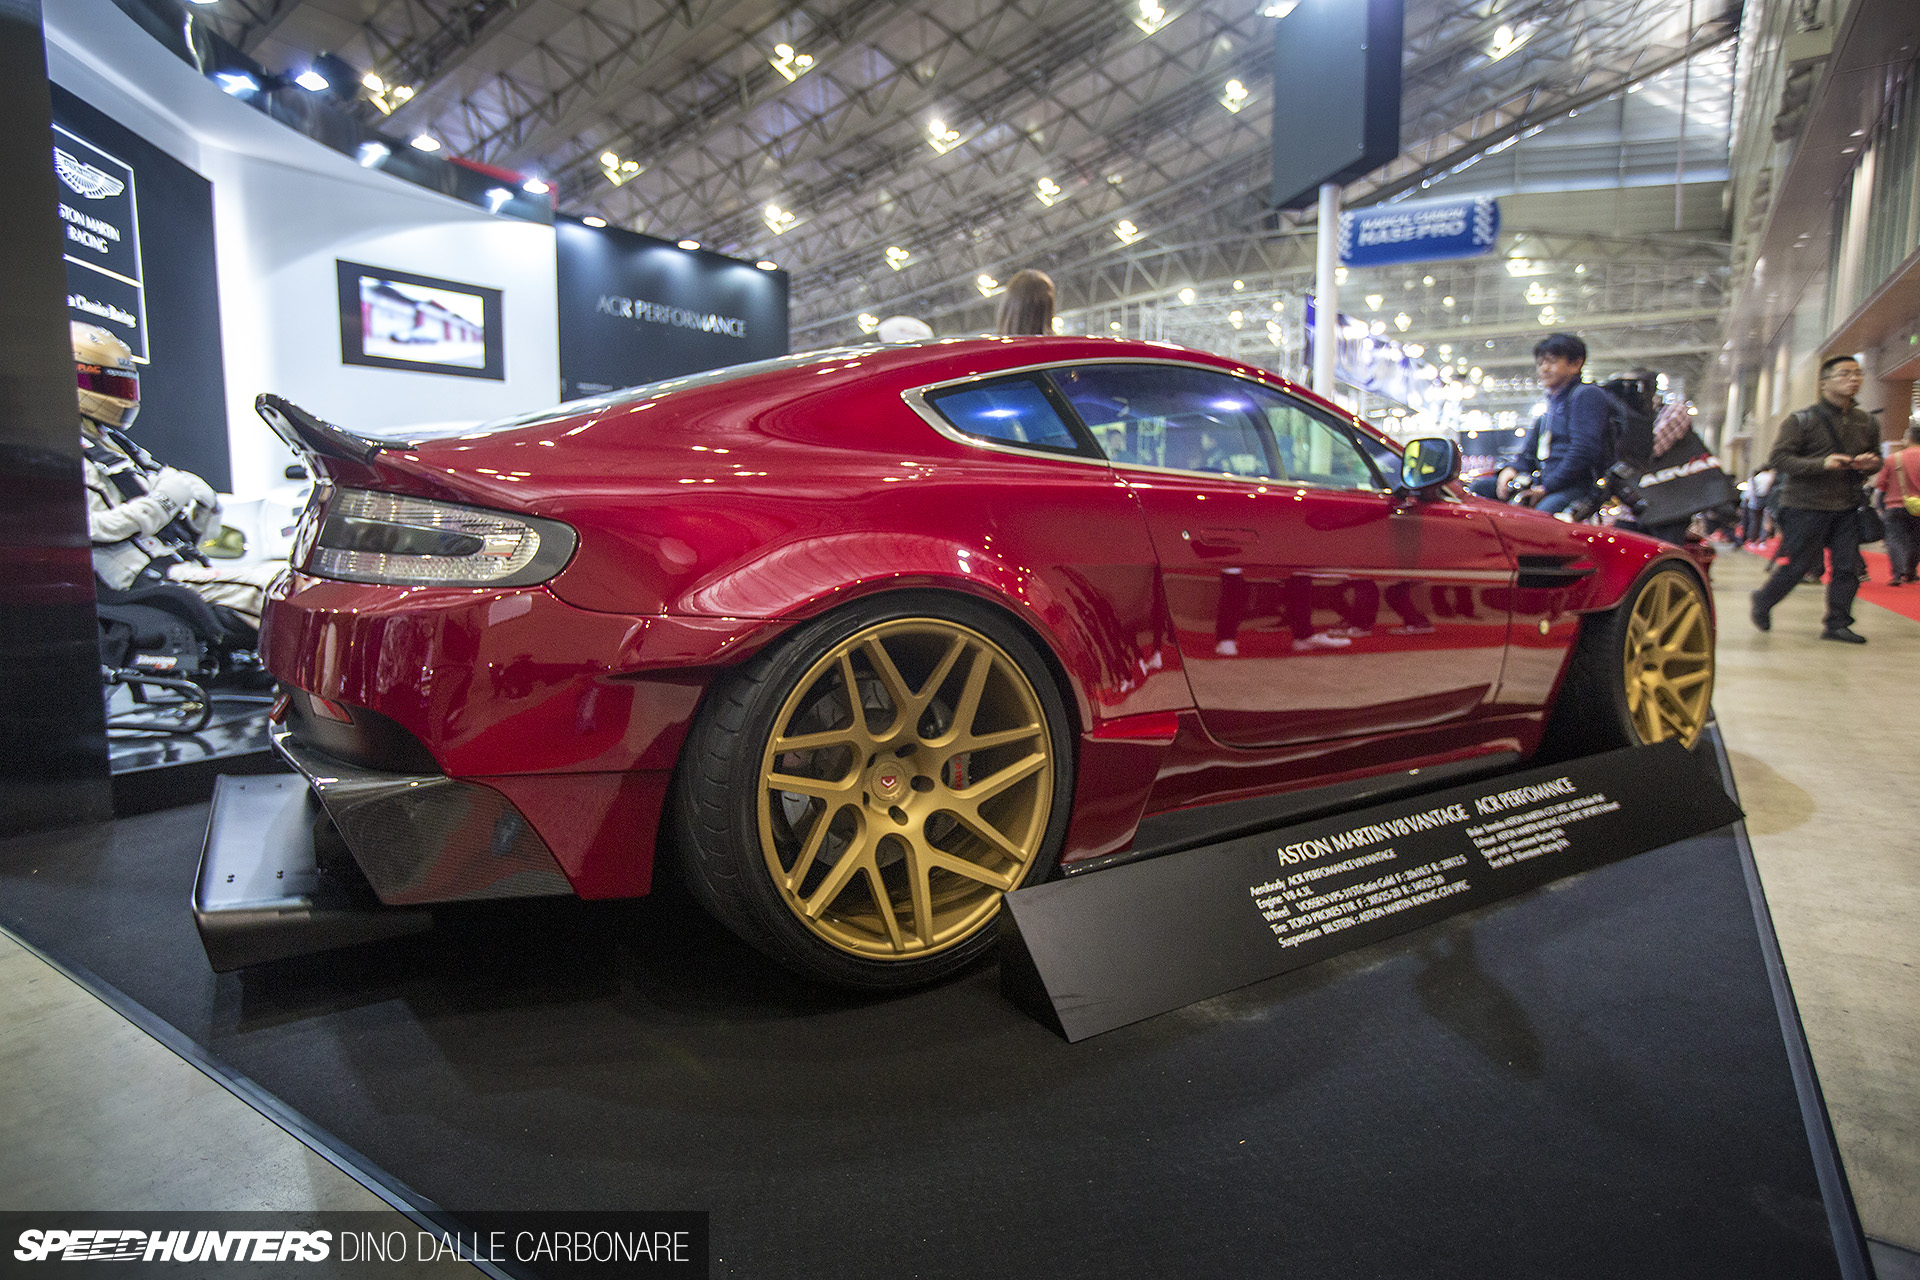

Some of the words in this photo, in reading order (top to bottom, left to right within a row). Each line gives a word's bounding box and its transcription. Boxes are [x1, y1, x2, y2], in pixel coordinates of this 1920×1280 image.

[57, 202, 86, 226] STON
[67, 224, 108, 254] RACING
[597, 295, 633, 319] ACR
[634, 299, 747, 338] PERFORMANCE
[1278, 837, 1333, 866] ASTON
[1330, 823, 1391, 852] MARTIN
[1385, 819, 1410, 837] V8
[1404, 804, 1470, 832] VANTAGE
[1475, 796, 1503, 815] ACR
[1288, 874, 1305, 886] ACR
[1256, 896, 1283, 909] Engine
[1262, 905, 1291, 921] Wheel
[1295, 895, 1329, 911] VOSSEN
[1270, 924, 1288, 934] Tire
[1287, 915, 1313, 929] TOYO
[1278, 929, 1322, 948] Suspension
